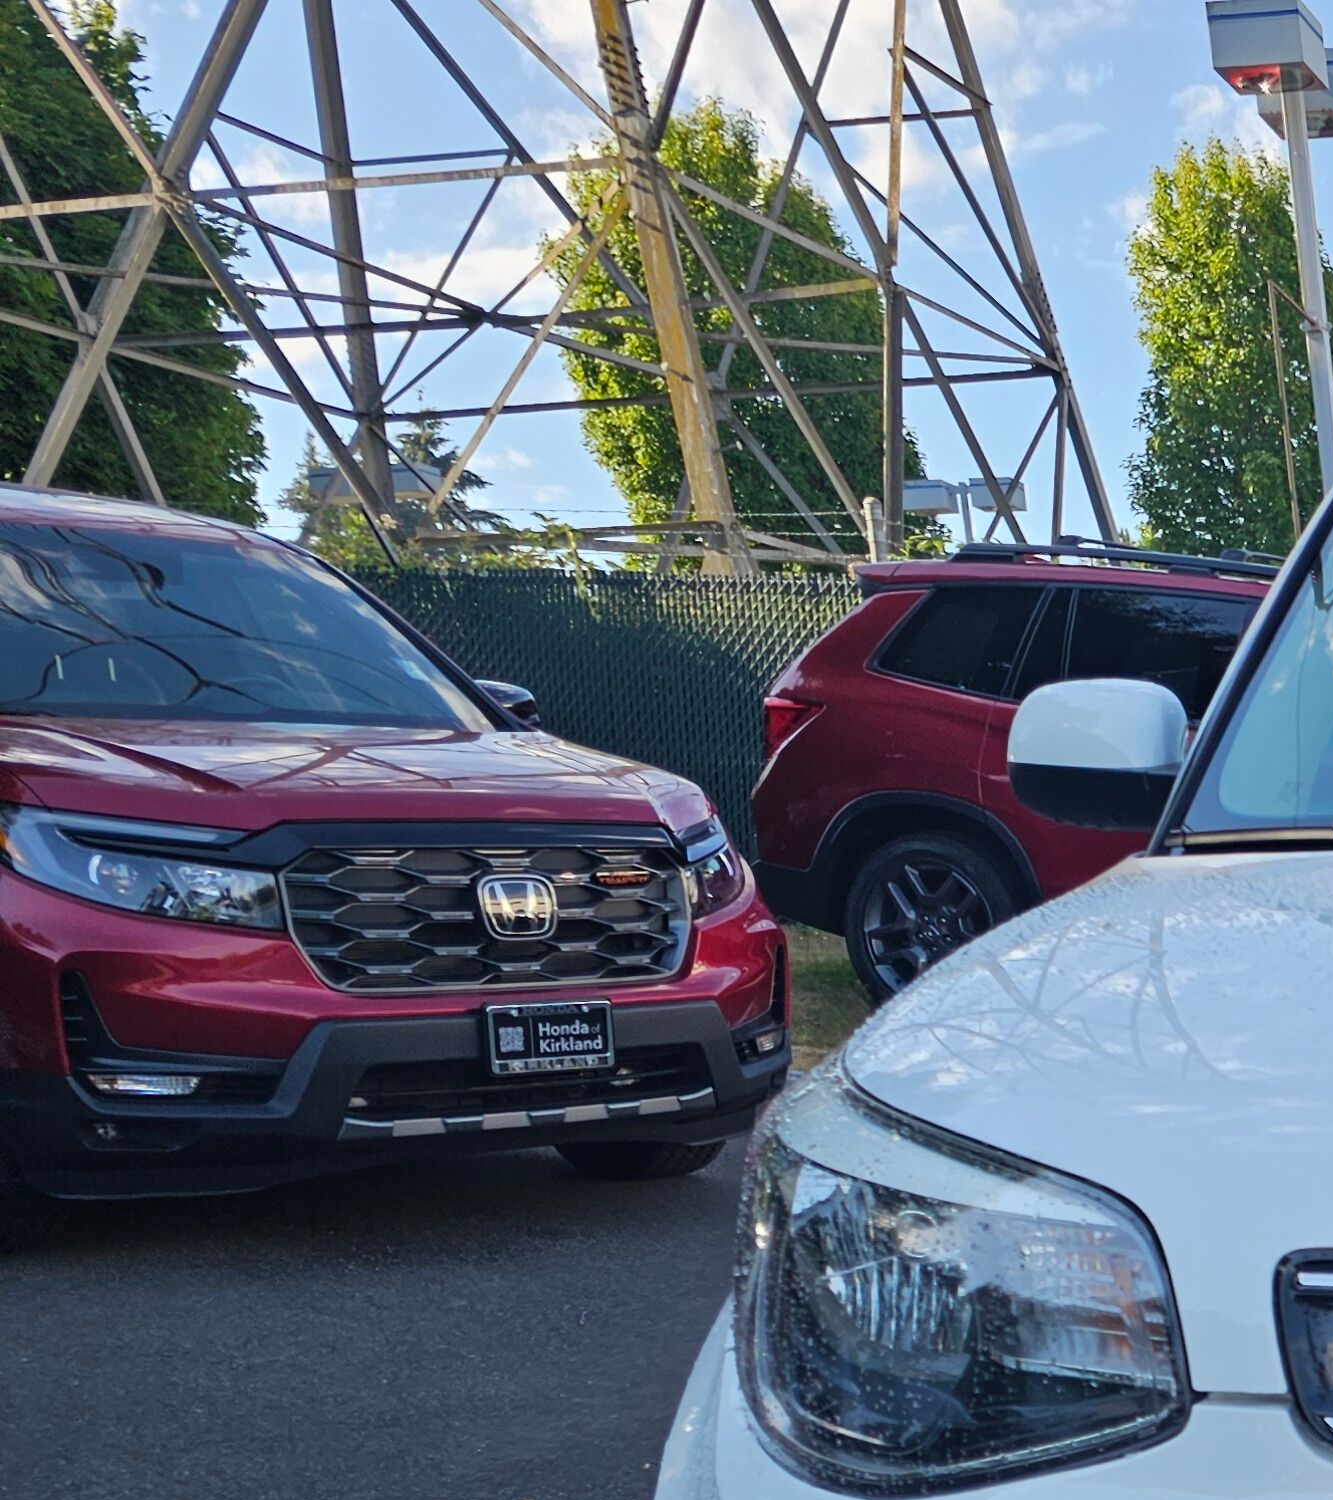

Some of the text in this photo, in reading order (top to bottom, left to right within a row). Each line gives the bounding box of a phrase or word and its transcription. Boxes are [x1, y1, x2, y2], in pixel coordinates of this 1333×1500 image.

[538, 1019, 601, 1037] Honda of
[539, 1035, 603, 1053] Kirkland
